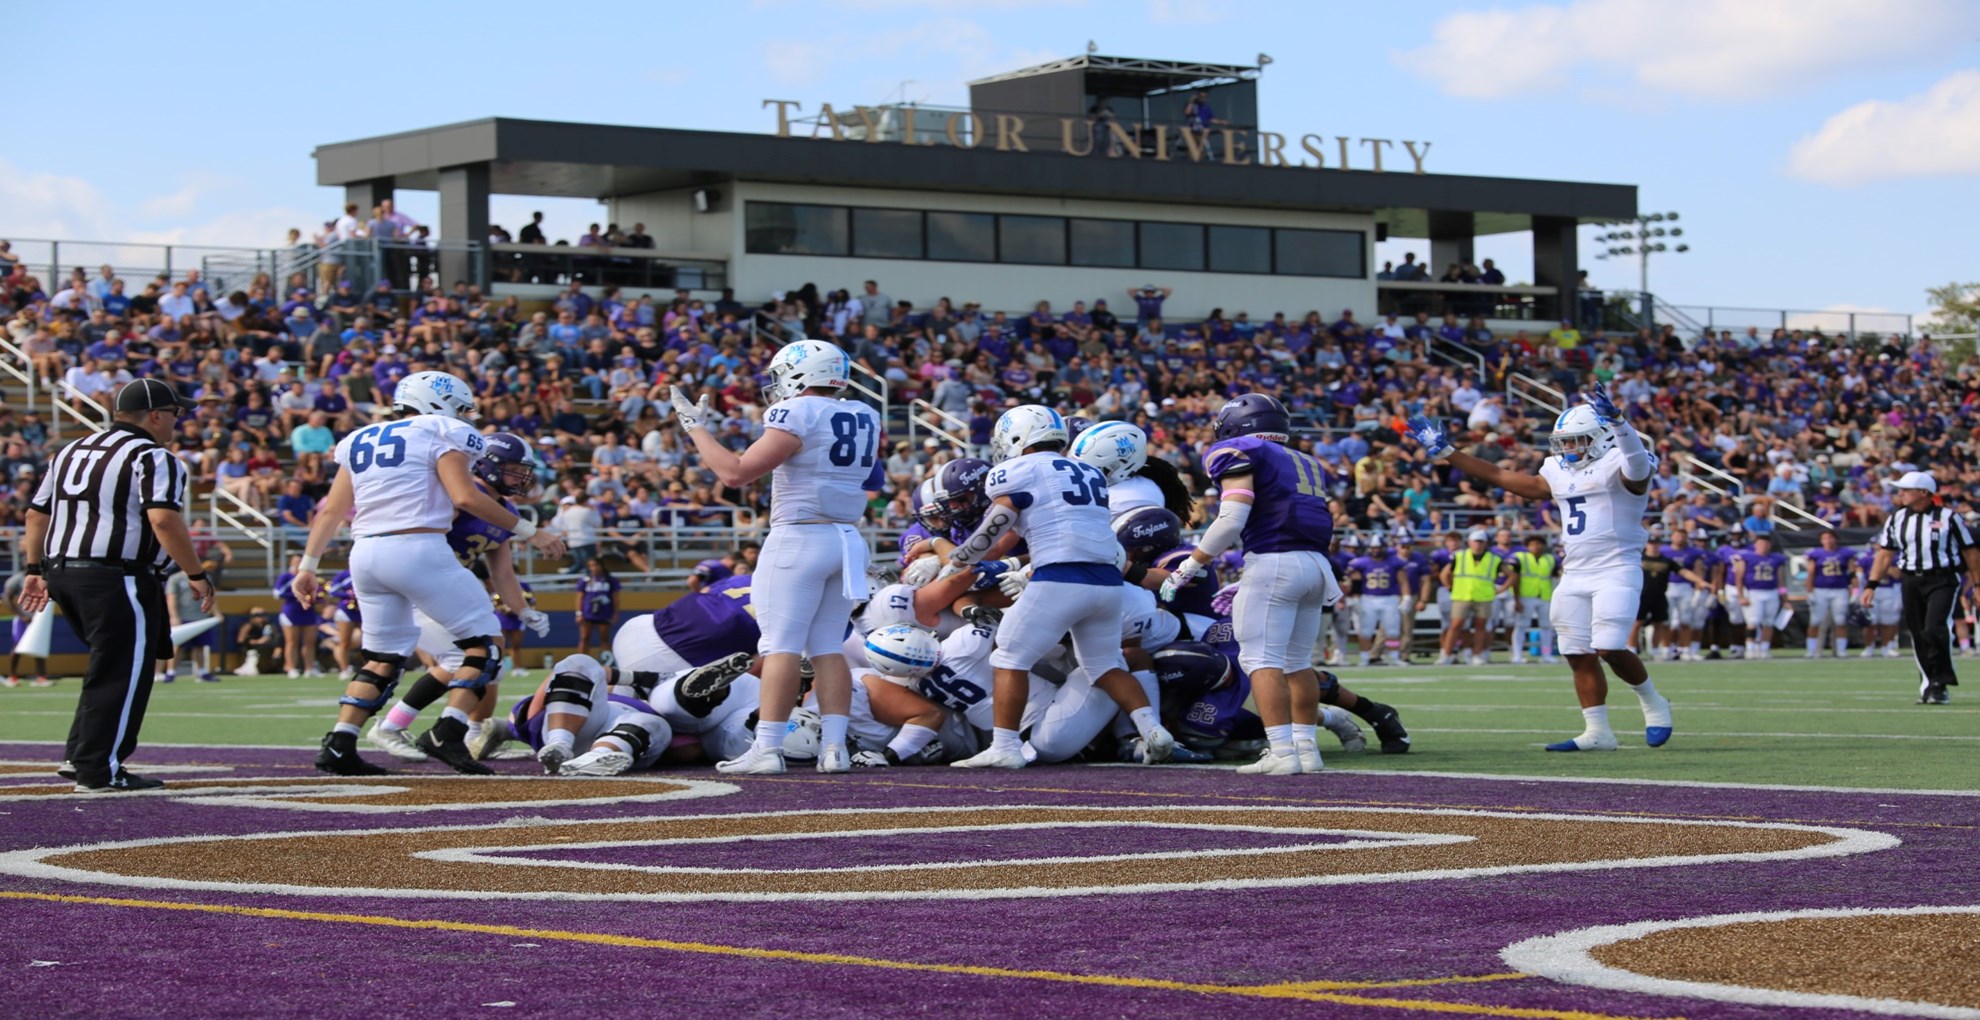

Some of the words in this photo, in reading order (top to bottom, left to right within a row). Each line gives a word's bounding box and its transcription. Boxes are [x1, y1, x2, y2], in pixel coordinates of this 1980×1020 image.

[763, 99, 1029, 152] TAYLOR
[1060, 117, 1432, 175] UNIVERSITY
[768, 408, 790, 424] 87
[349, 420, 414, 475] 65
[466, 433, 484, 451] 65
[829, 412, 875, 467] 87
[63, 449, 107, 495] U
[989, 468, 1008, 487] 32
[1283, 446, 1326, 498] 11
[1052, 459, 1109, 509] 32
[1566, 496, 1587, 536] 5
[1132, 520, 1169, 539] Trojans
[1753, 563, 1774, 581] 12
[1822, 560, 1843, 576] 21
[889, 595, 909, 611] 17
[1134, 617, 1153, 634] 74
[1186, 702, 1218, 726] 52
